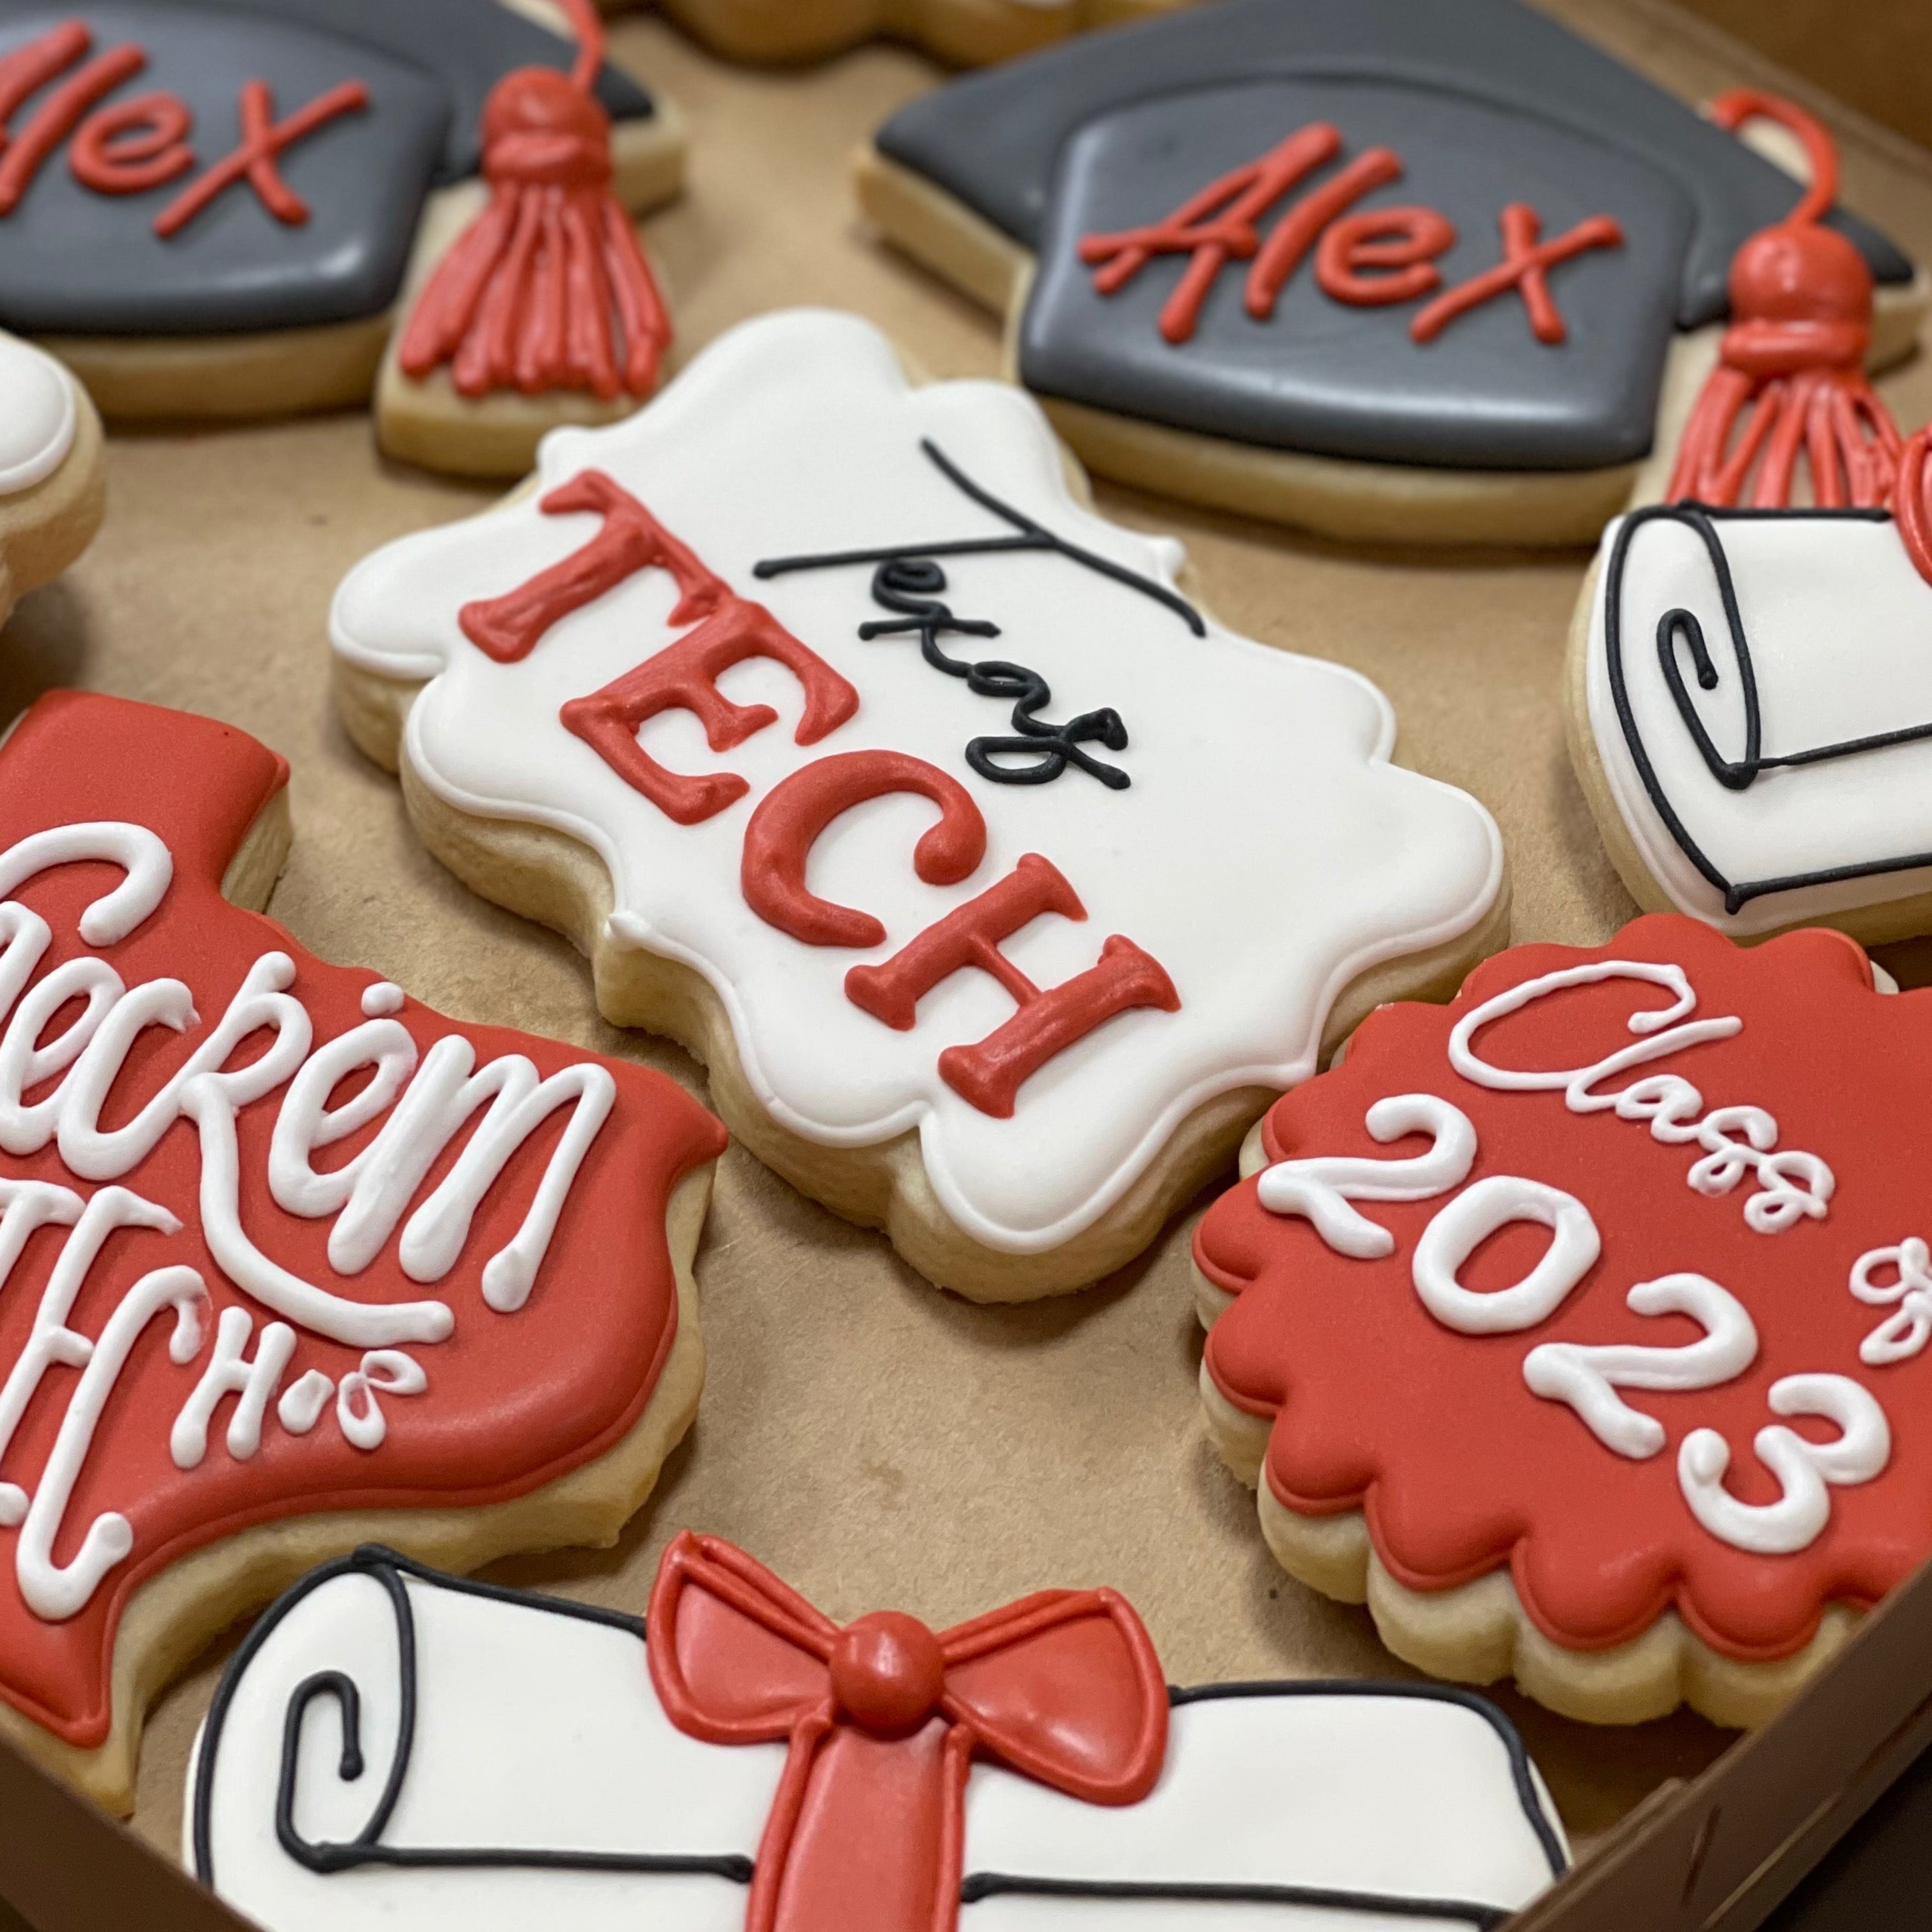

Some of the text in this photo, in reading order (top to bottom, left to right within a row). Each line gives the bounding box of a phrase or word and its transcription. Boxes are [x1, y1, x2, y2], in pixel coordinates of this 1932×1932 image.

[1078, 122, 1623, 345] Alex
[752, 437, 1206, 789] Texas
[458, 468, 1182, 1118] TECH
[1448, 960, 1835, 1233] Class
[1256, 1093, 1891, 1553] 2023
